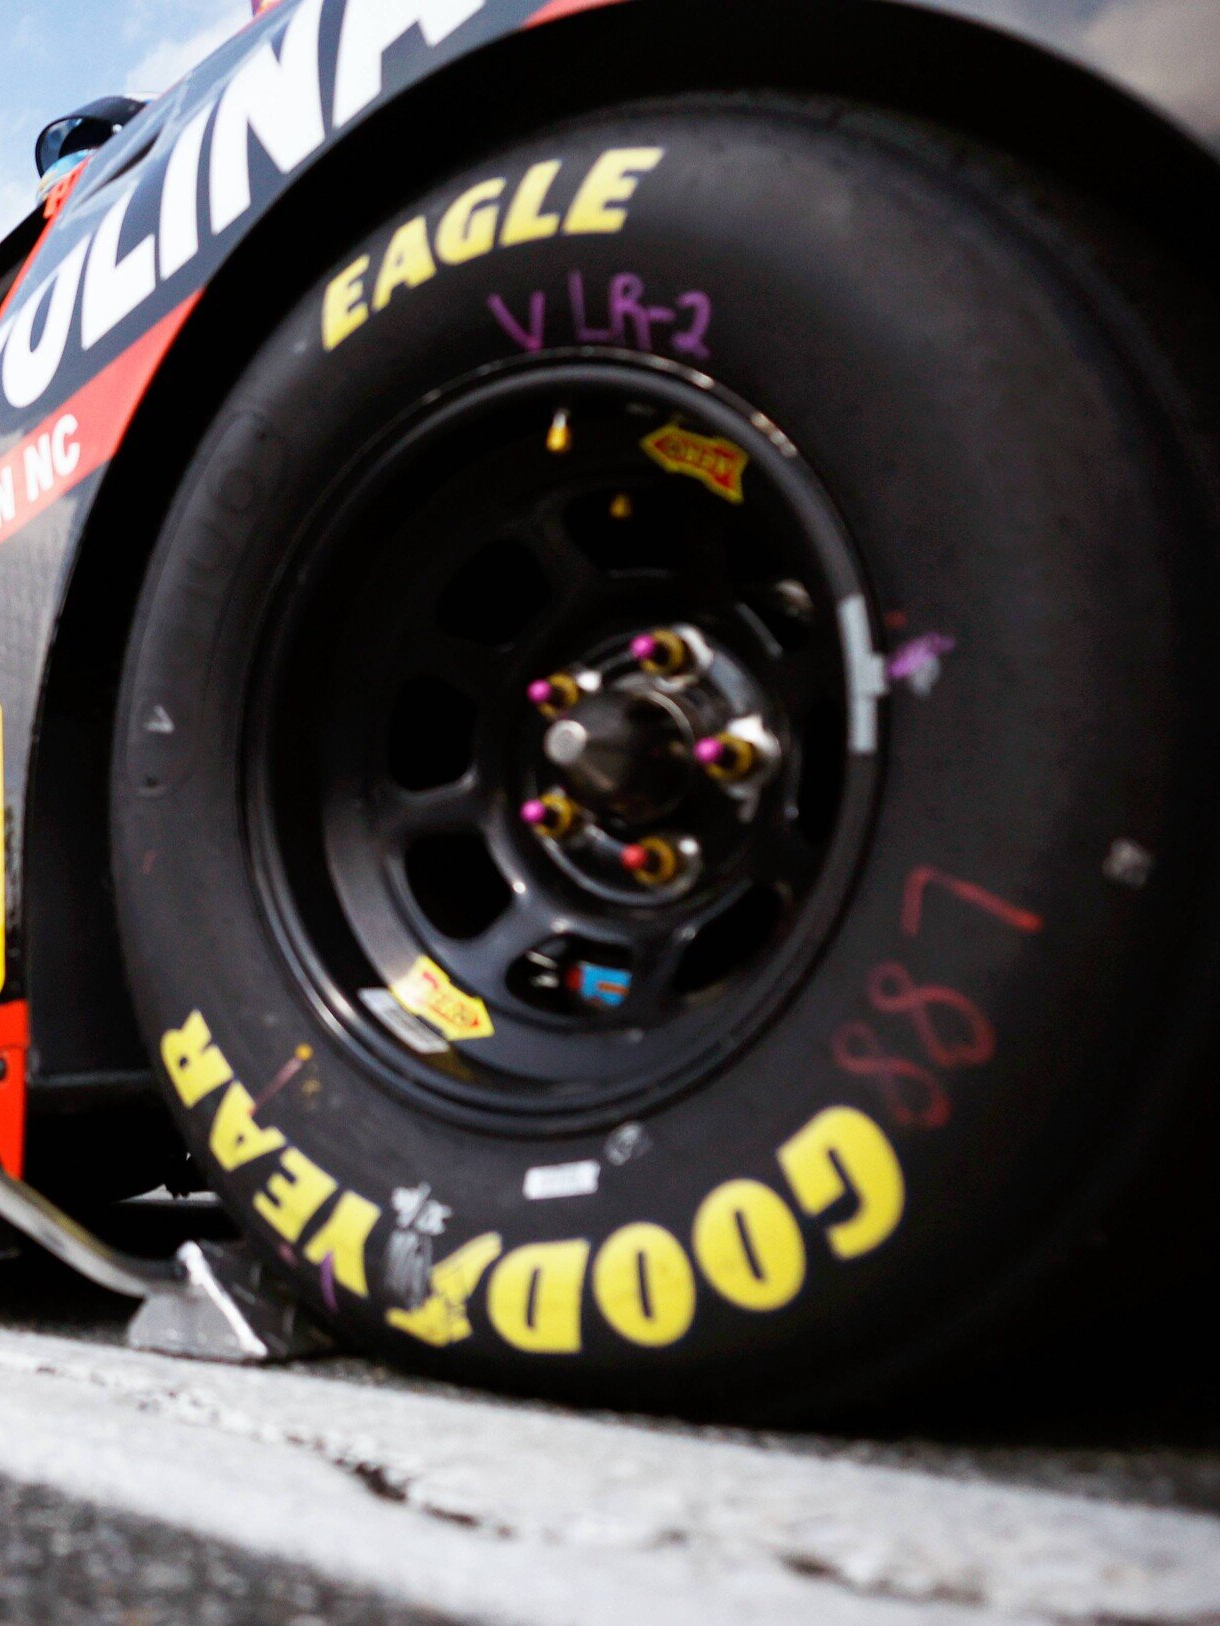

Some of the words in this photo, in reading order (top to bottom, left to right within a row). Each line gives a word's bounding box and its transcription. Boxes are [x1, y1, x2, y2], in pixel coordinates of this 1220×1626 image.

[321, 147, 664, 352] EAGLE
[23, 414, 80, 503] NC
[161, 1009, 905, 1354] GOODYEAR
